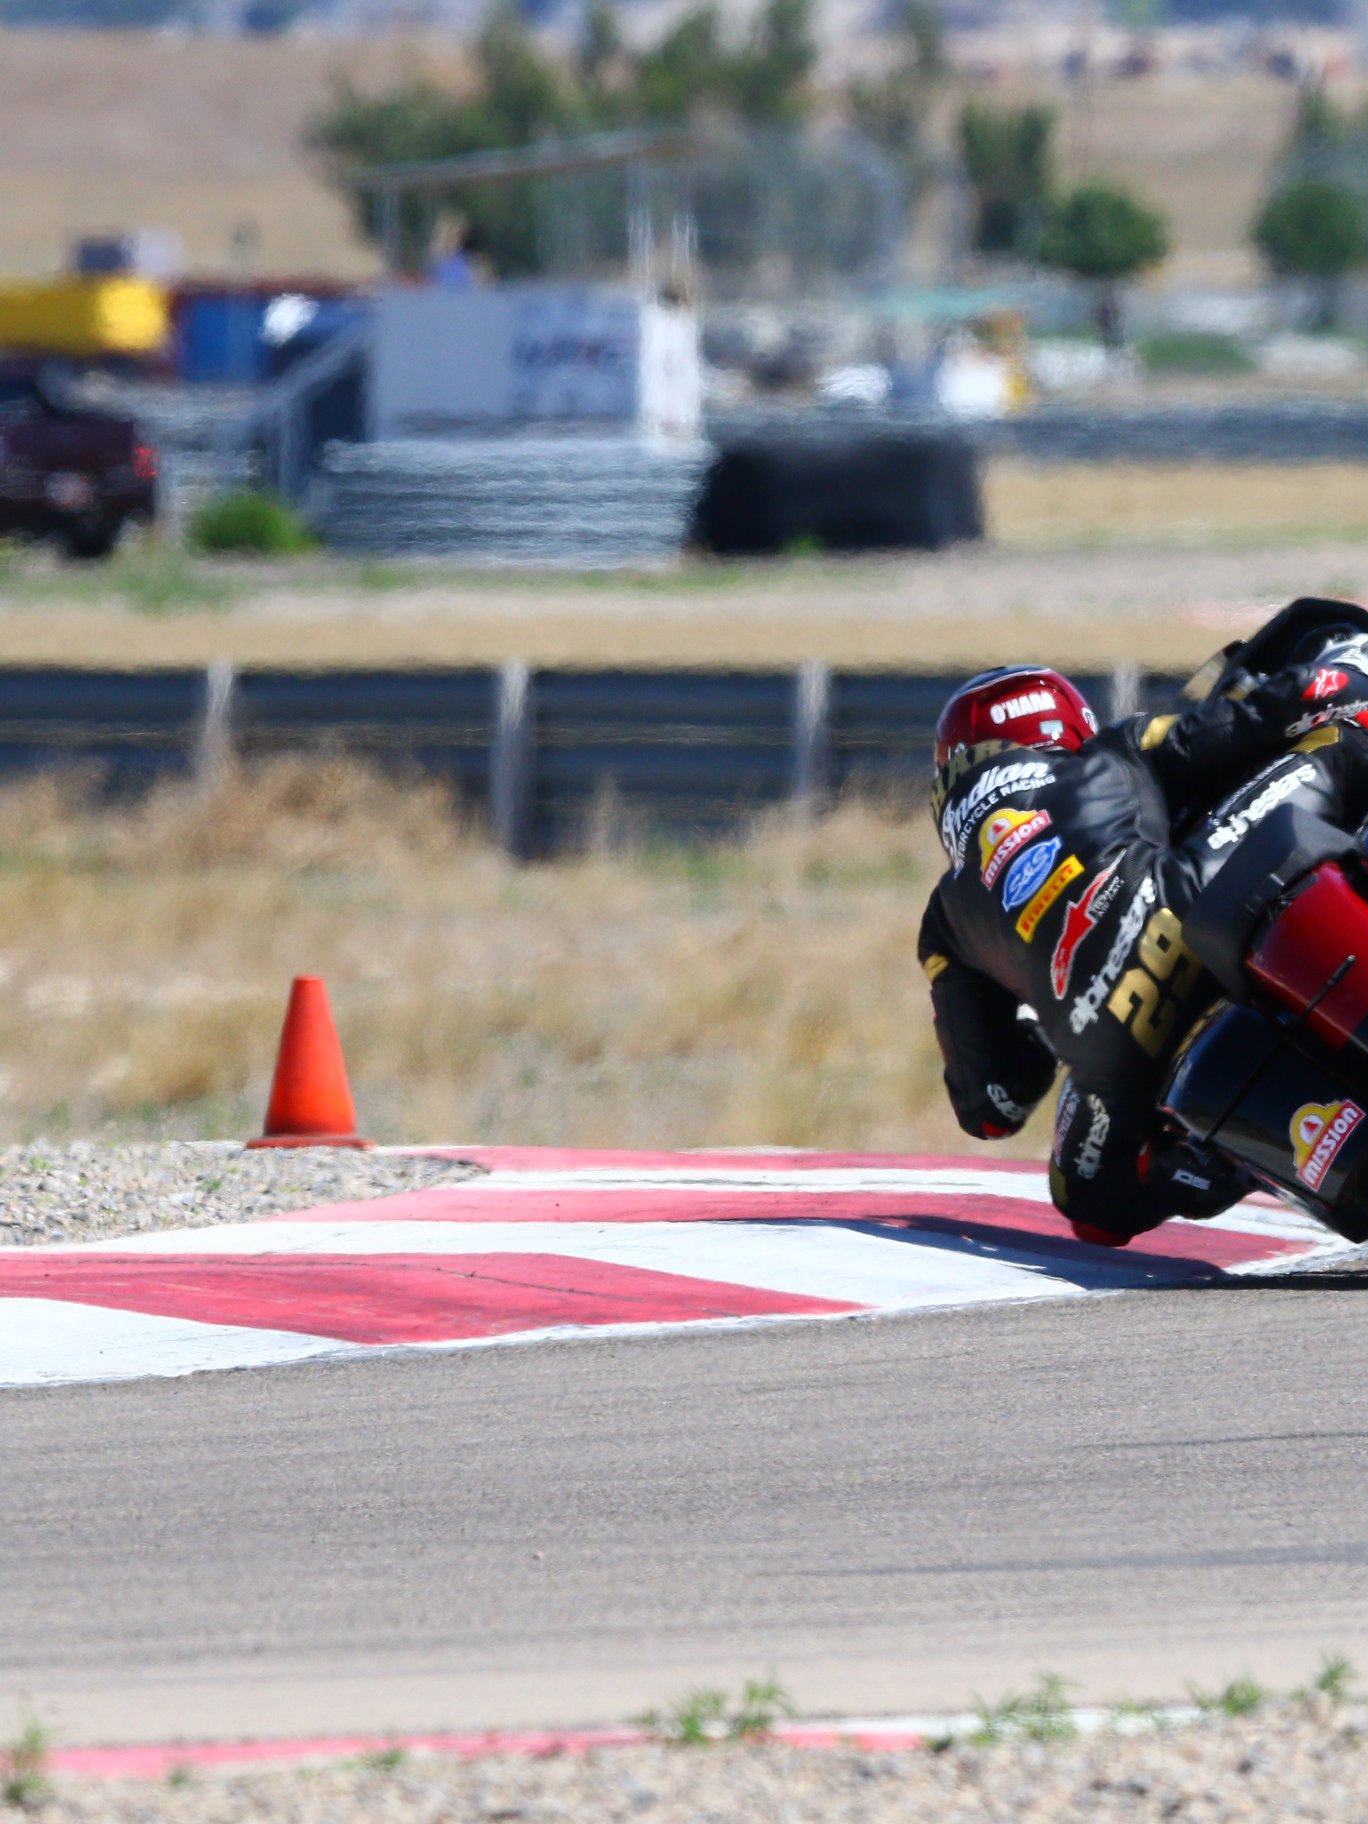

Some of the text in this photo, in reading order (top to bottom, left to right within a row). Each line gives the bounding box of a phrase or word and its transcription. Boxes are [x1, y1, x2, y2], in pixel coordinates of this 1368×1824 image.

[989, 690, 1056, 724] O'HARA
[942, 762, 1049, 878] Indian
[1000, 774, 1056, 797] RACING
[1106, 907, 1202, 1056] 29
